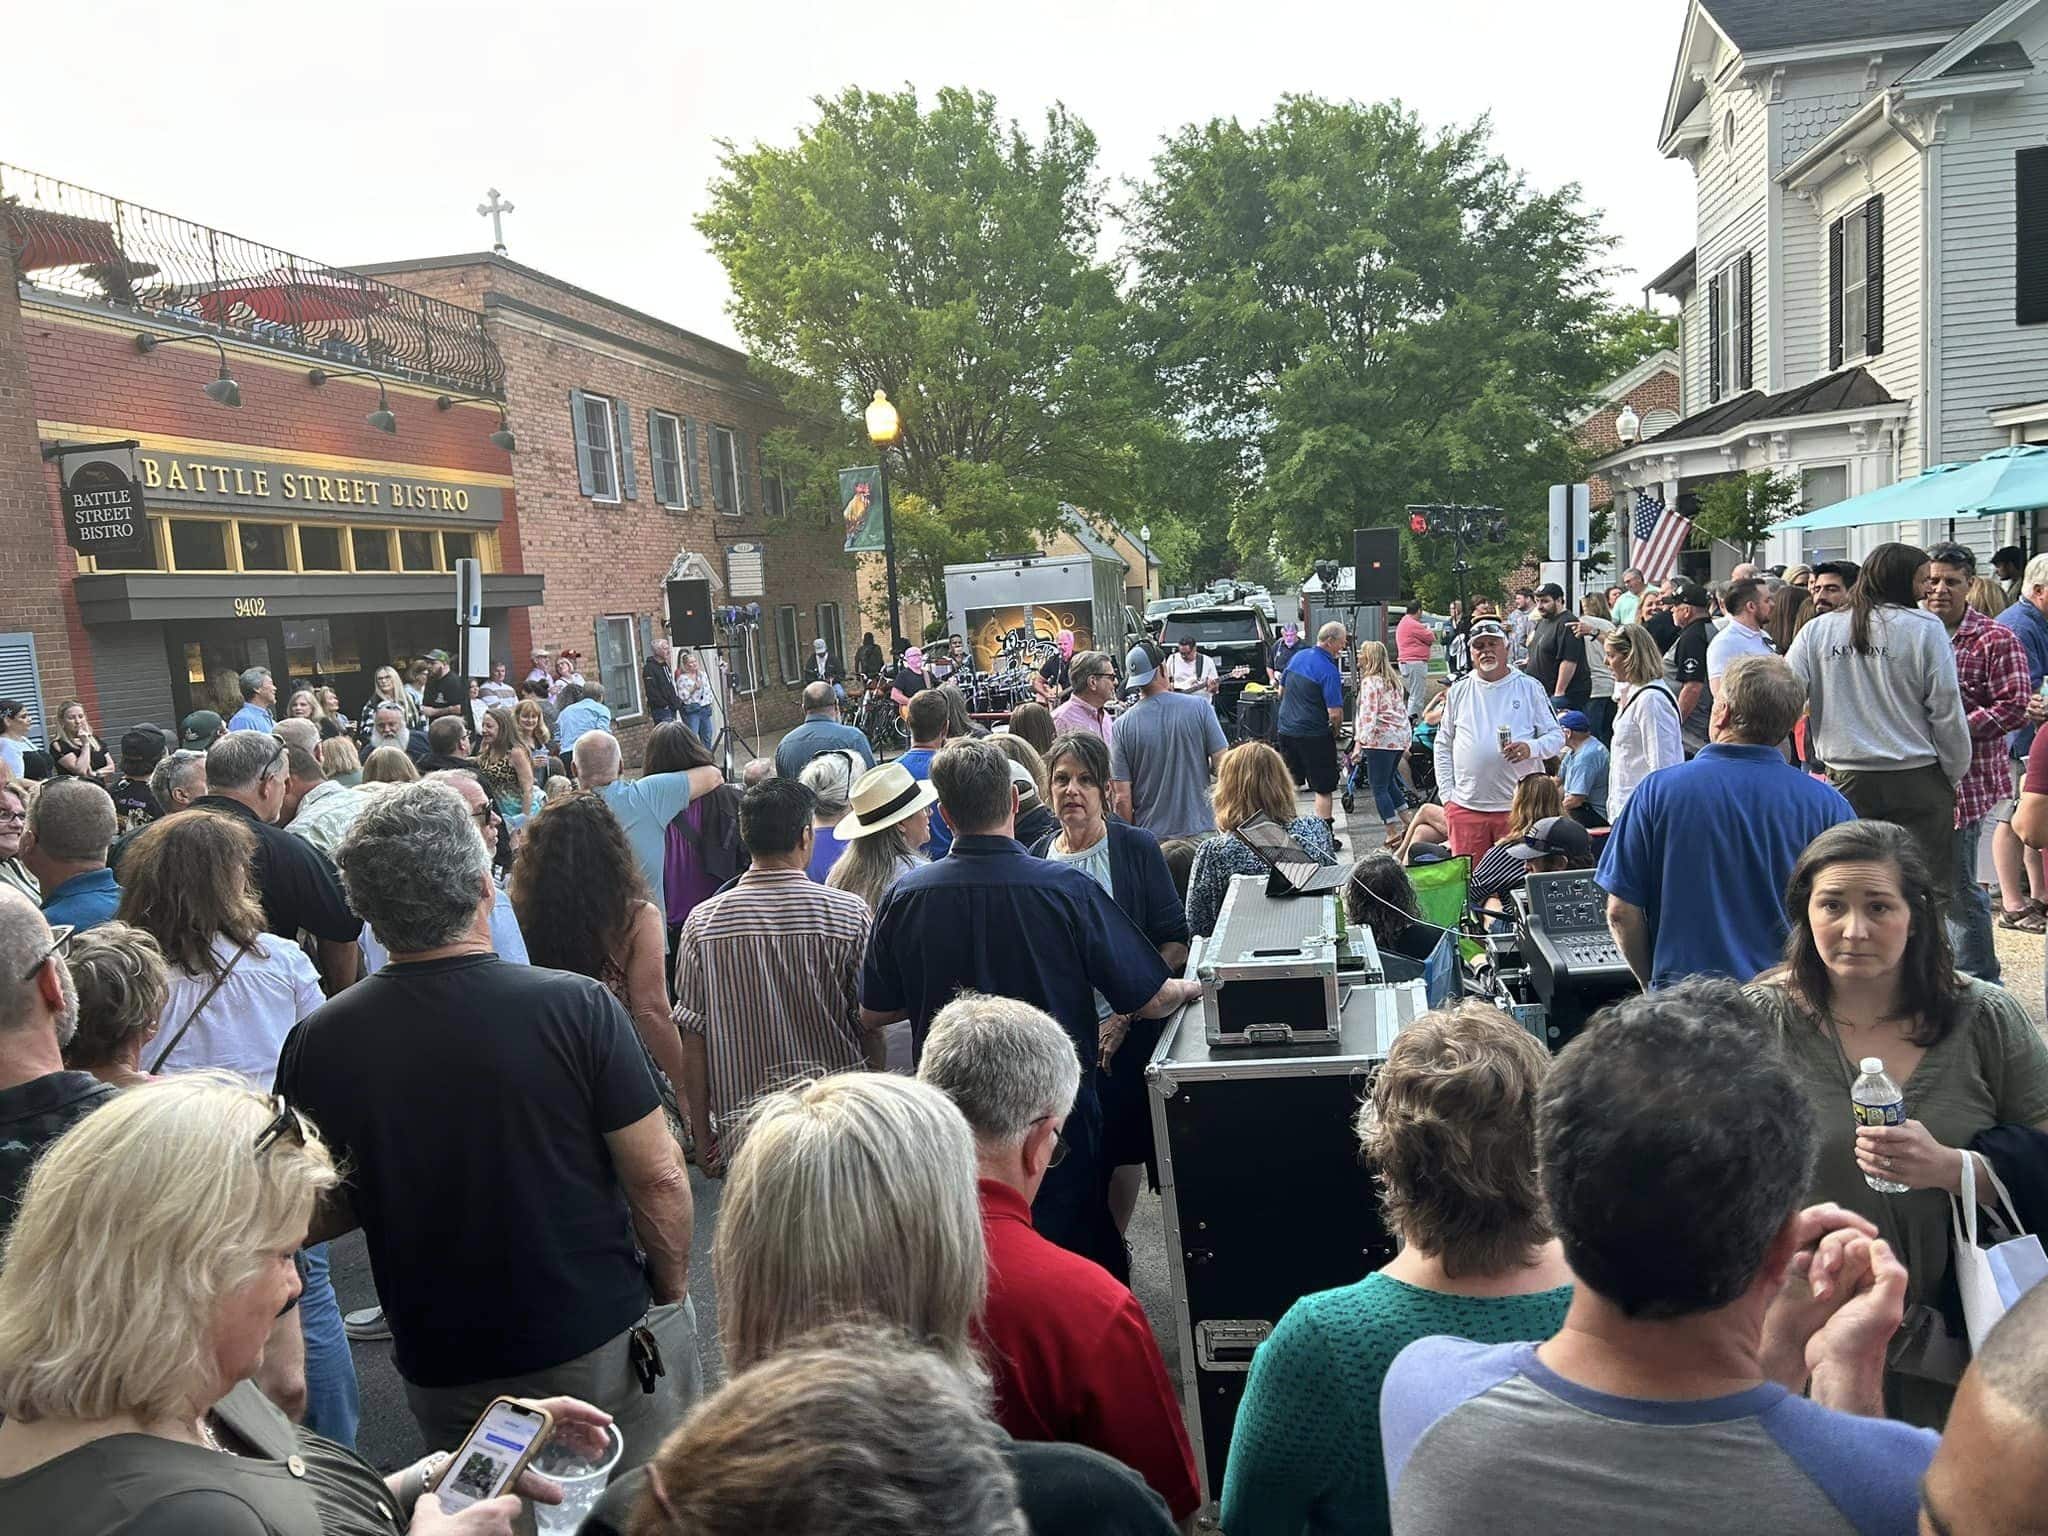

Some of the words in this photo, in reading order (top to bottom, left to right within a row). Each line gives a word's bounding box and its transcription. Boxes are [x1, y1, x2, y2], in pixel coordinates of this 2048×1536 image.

[140, 458, 270, 497] BATTLE
[283, 473, 380, 505] STREET
[391, 483, 468, 511] BISTRO
[73, 490, 131, 507] BATTLE
[75, 507, 132, 523] STREET
[80, 524, 133, 540] BISTRO
[235, 598, 266, 616] 9402
